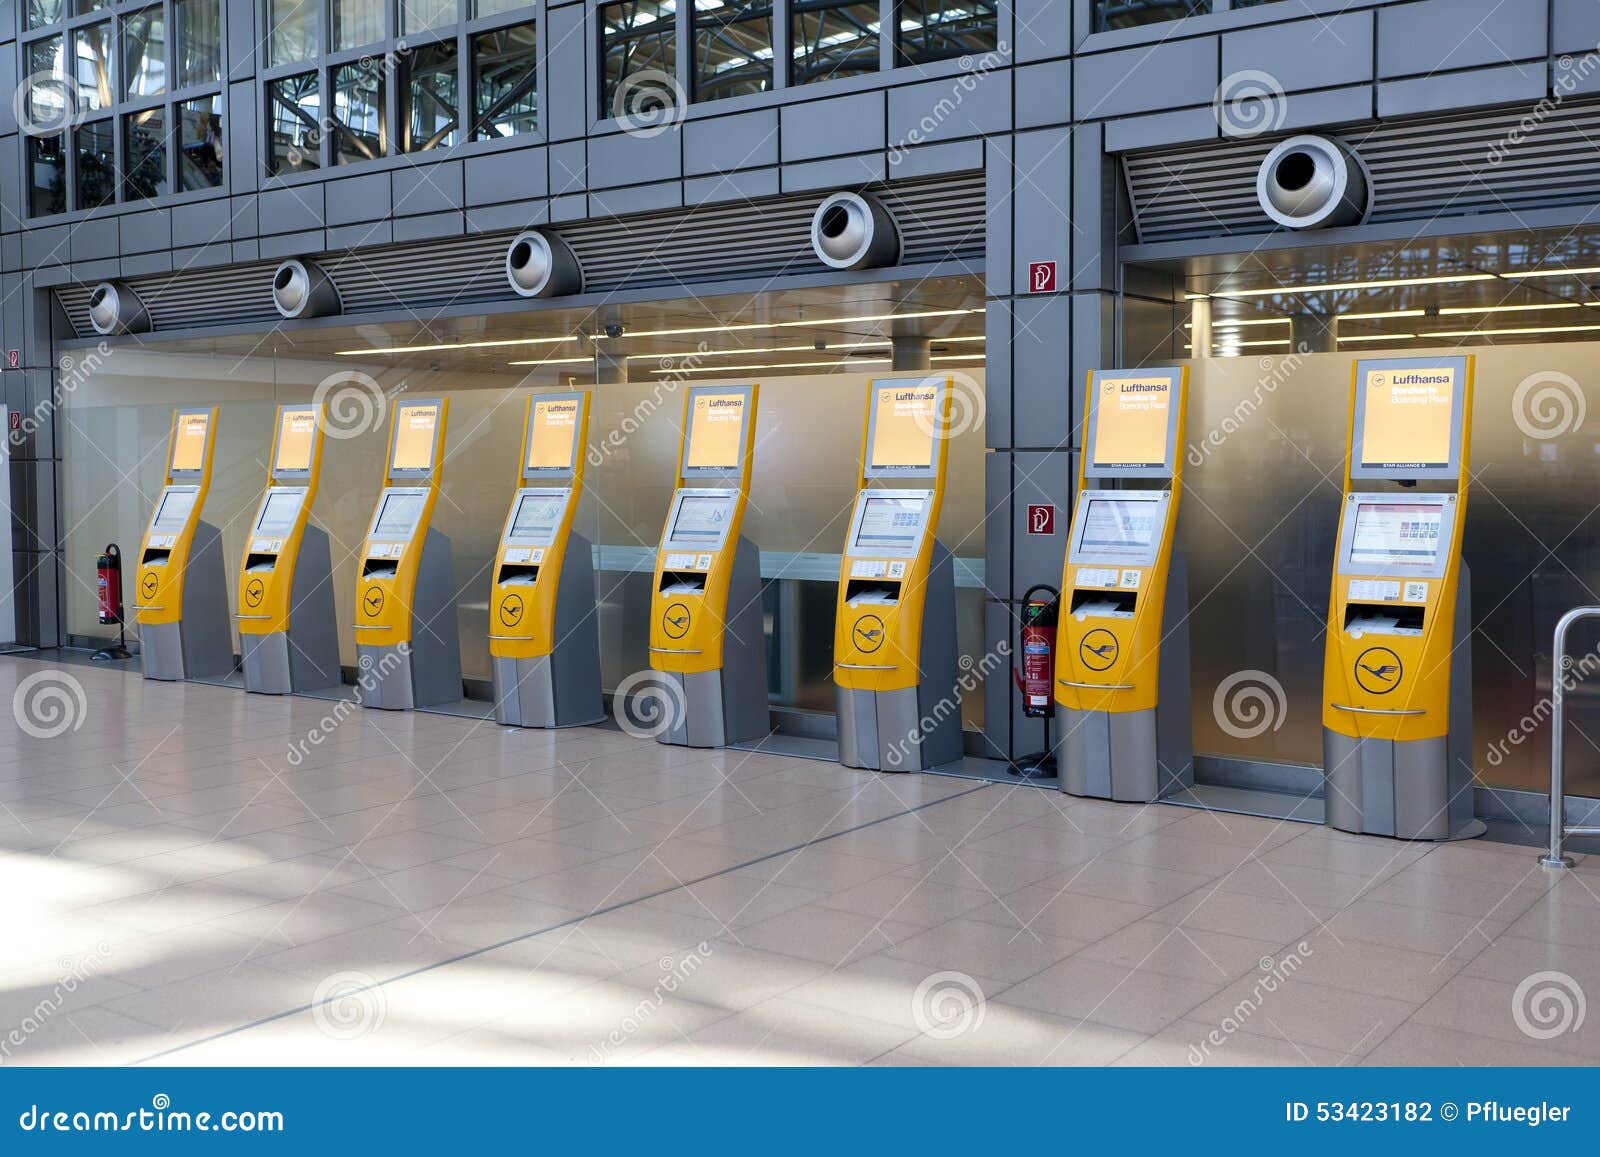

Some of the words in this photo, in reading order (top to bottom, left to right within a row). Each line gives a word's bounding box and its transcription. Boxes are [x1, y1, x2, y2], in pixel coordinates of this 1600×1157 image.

[1393, 374, 1449, 384] Lufthansa
[1121, 383, 1168, 392] Lufthansa
[895, 393, 935, 401] Lufthansa
[709, 399, 744, 407] Lufthansa
